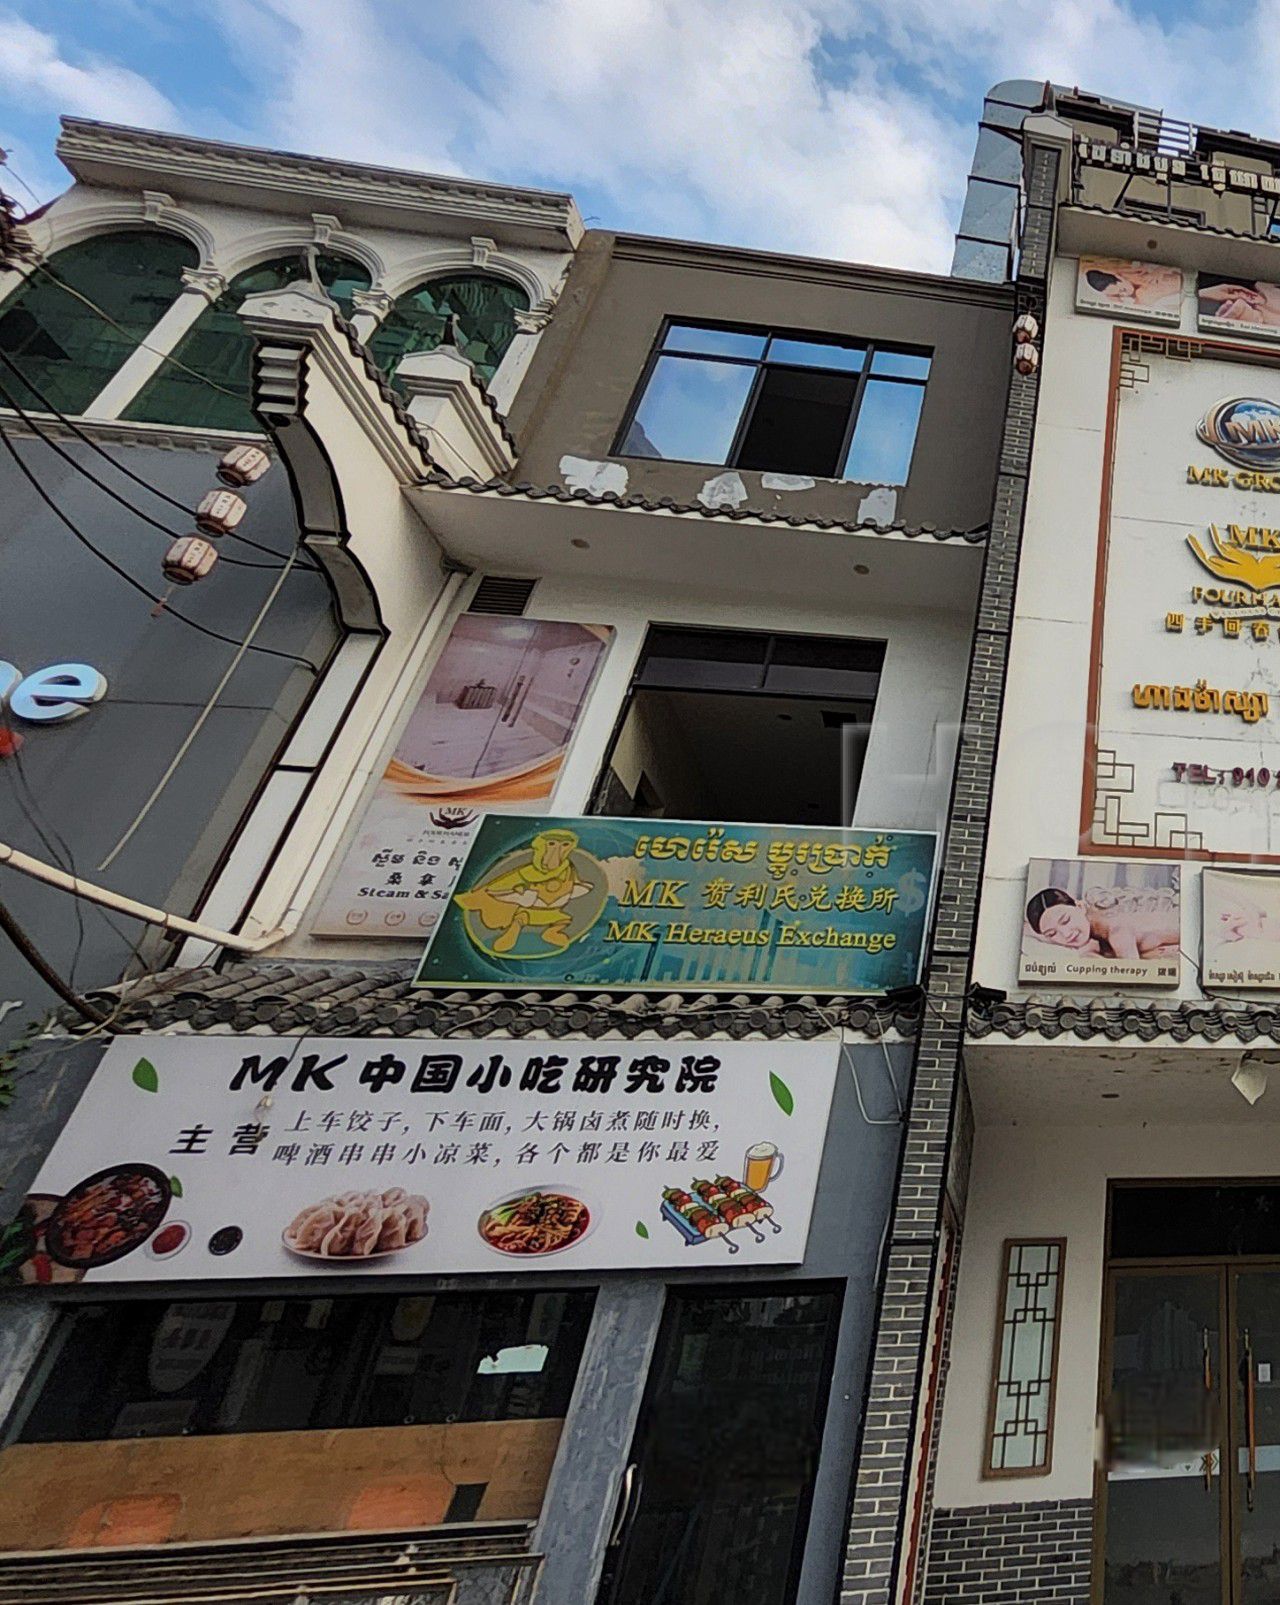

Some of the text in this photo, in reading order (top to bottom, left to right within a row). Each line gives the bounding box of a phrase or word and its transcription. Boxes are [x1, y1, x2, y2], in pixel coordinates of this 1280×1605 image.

[1186, 465, 1229, 488] MK
[357, 887, 411, 898] Steam
[414, 890, 428, 899] &
[621, 879, 688, 908] MK
[603, 922, 897, 954] MK Heraeus Exchange
[1067, 964, 1148, 977] Cupping therapy
[229, 1053, 721, 1094] MK 中国小吃研究院
